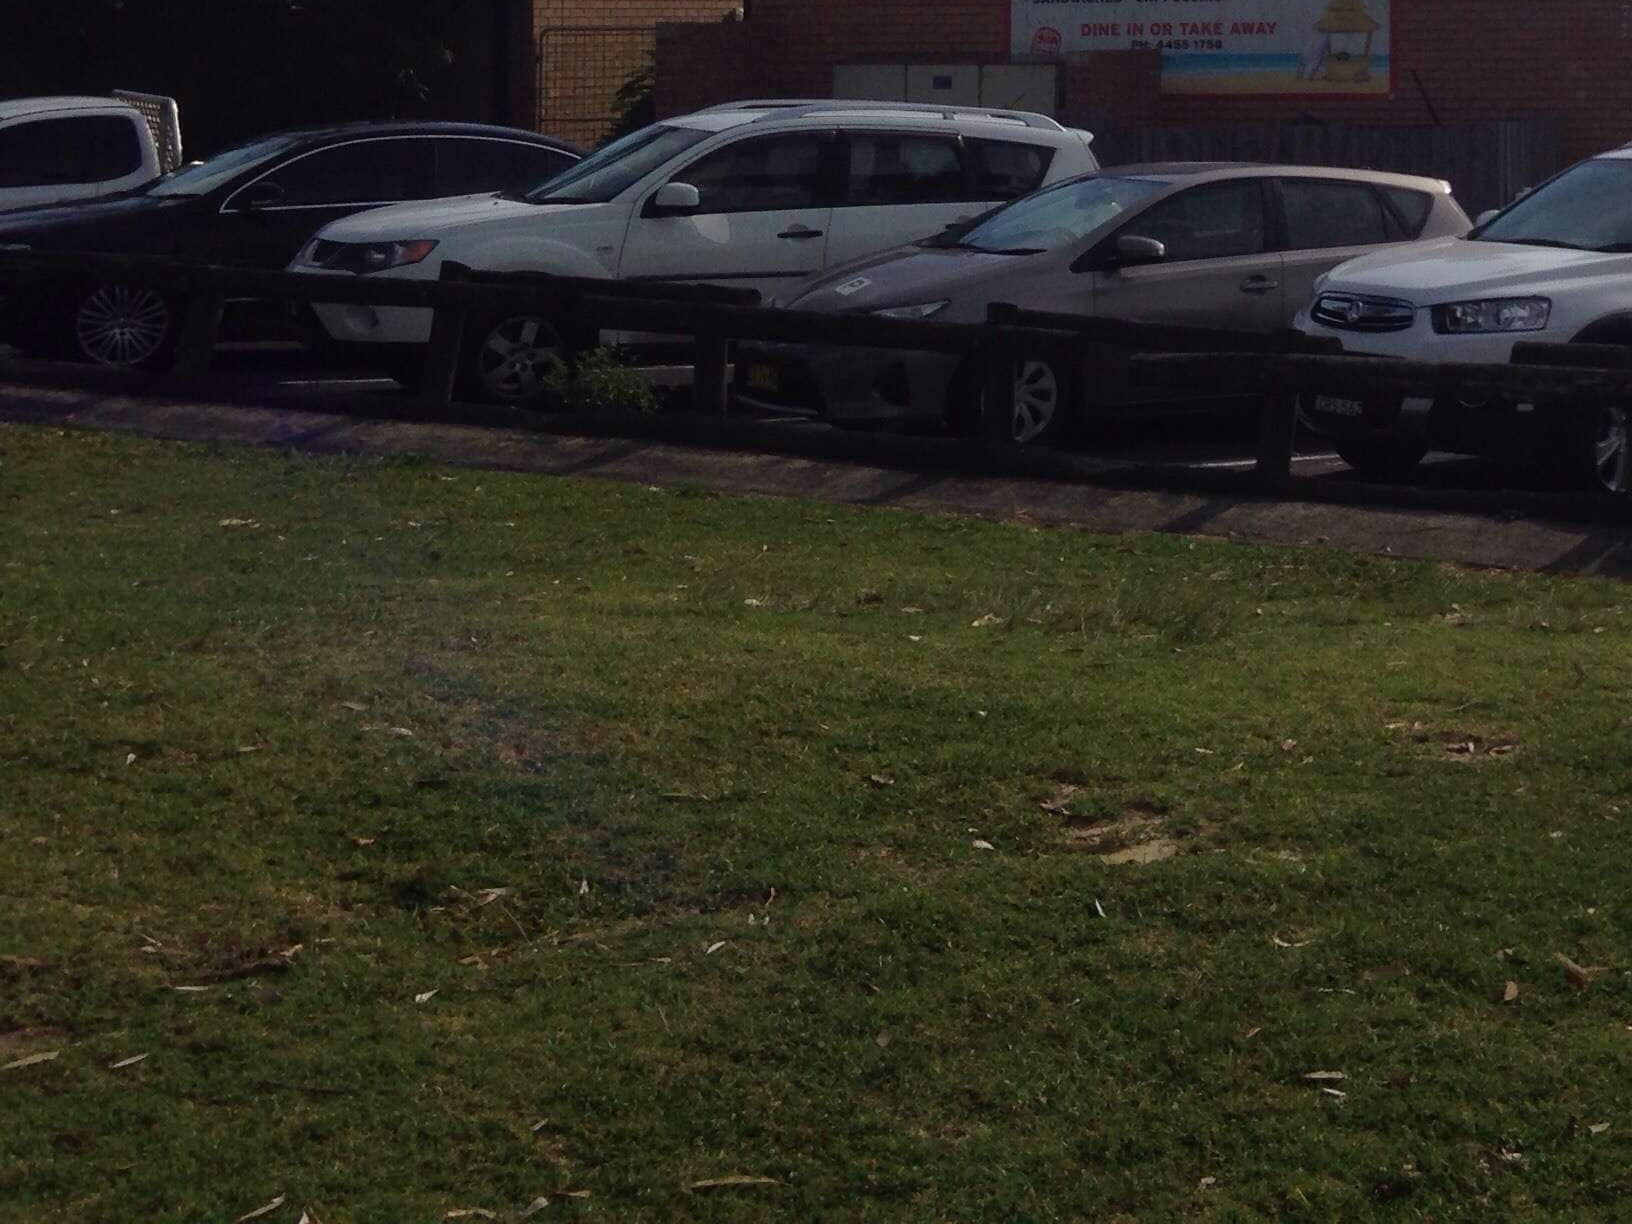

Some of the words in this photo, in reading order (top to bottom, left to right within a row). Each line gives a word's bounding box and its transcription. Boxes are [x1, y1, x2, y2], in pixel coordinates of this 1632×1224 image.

[1080, 23, 1121, 36] DINE
[1127, 23, 1144, 36] IN
[1150, 22, 1172, 35] OR
[1179, 22, 1223, 35] TAKE
[1229, 21, 1277, 35] AWAY
[1156, 39, 1189, 49] 4455
